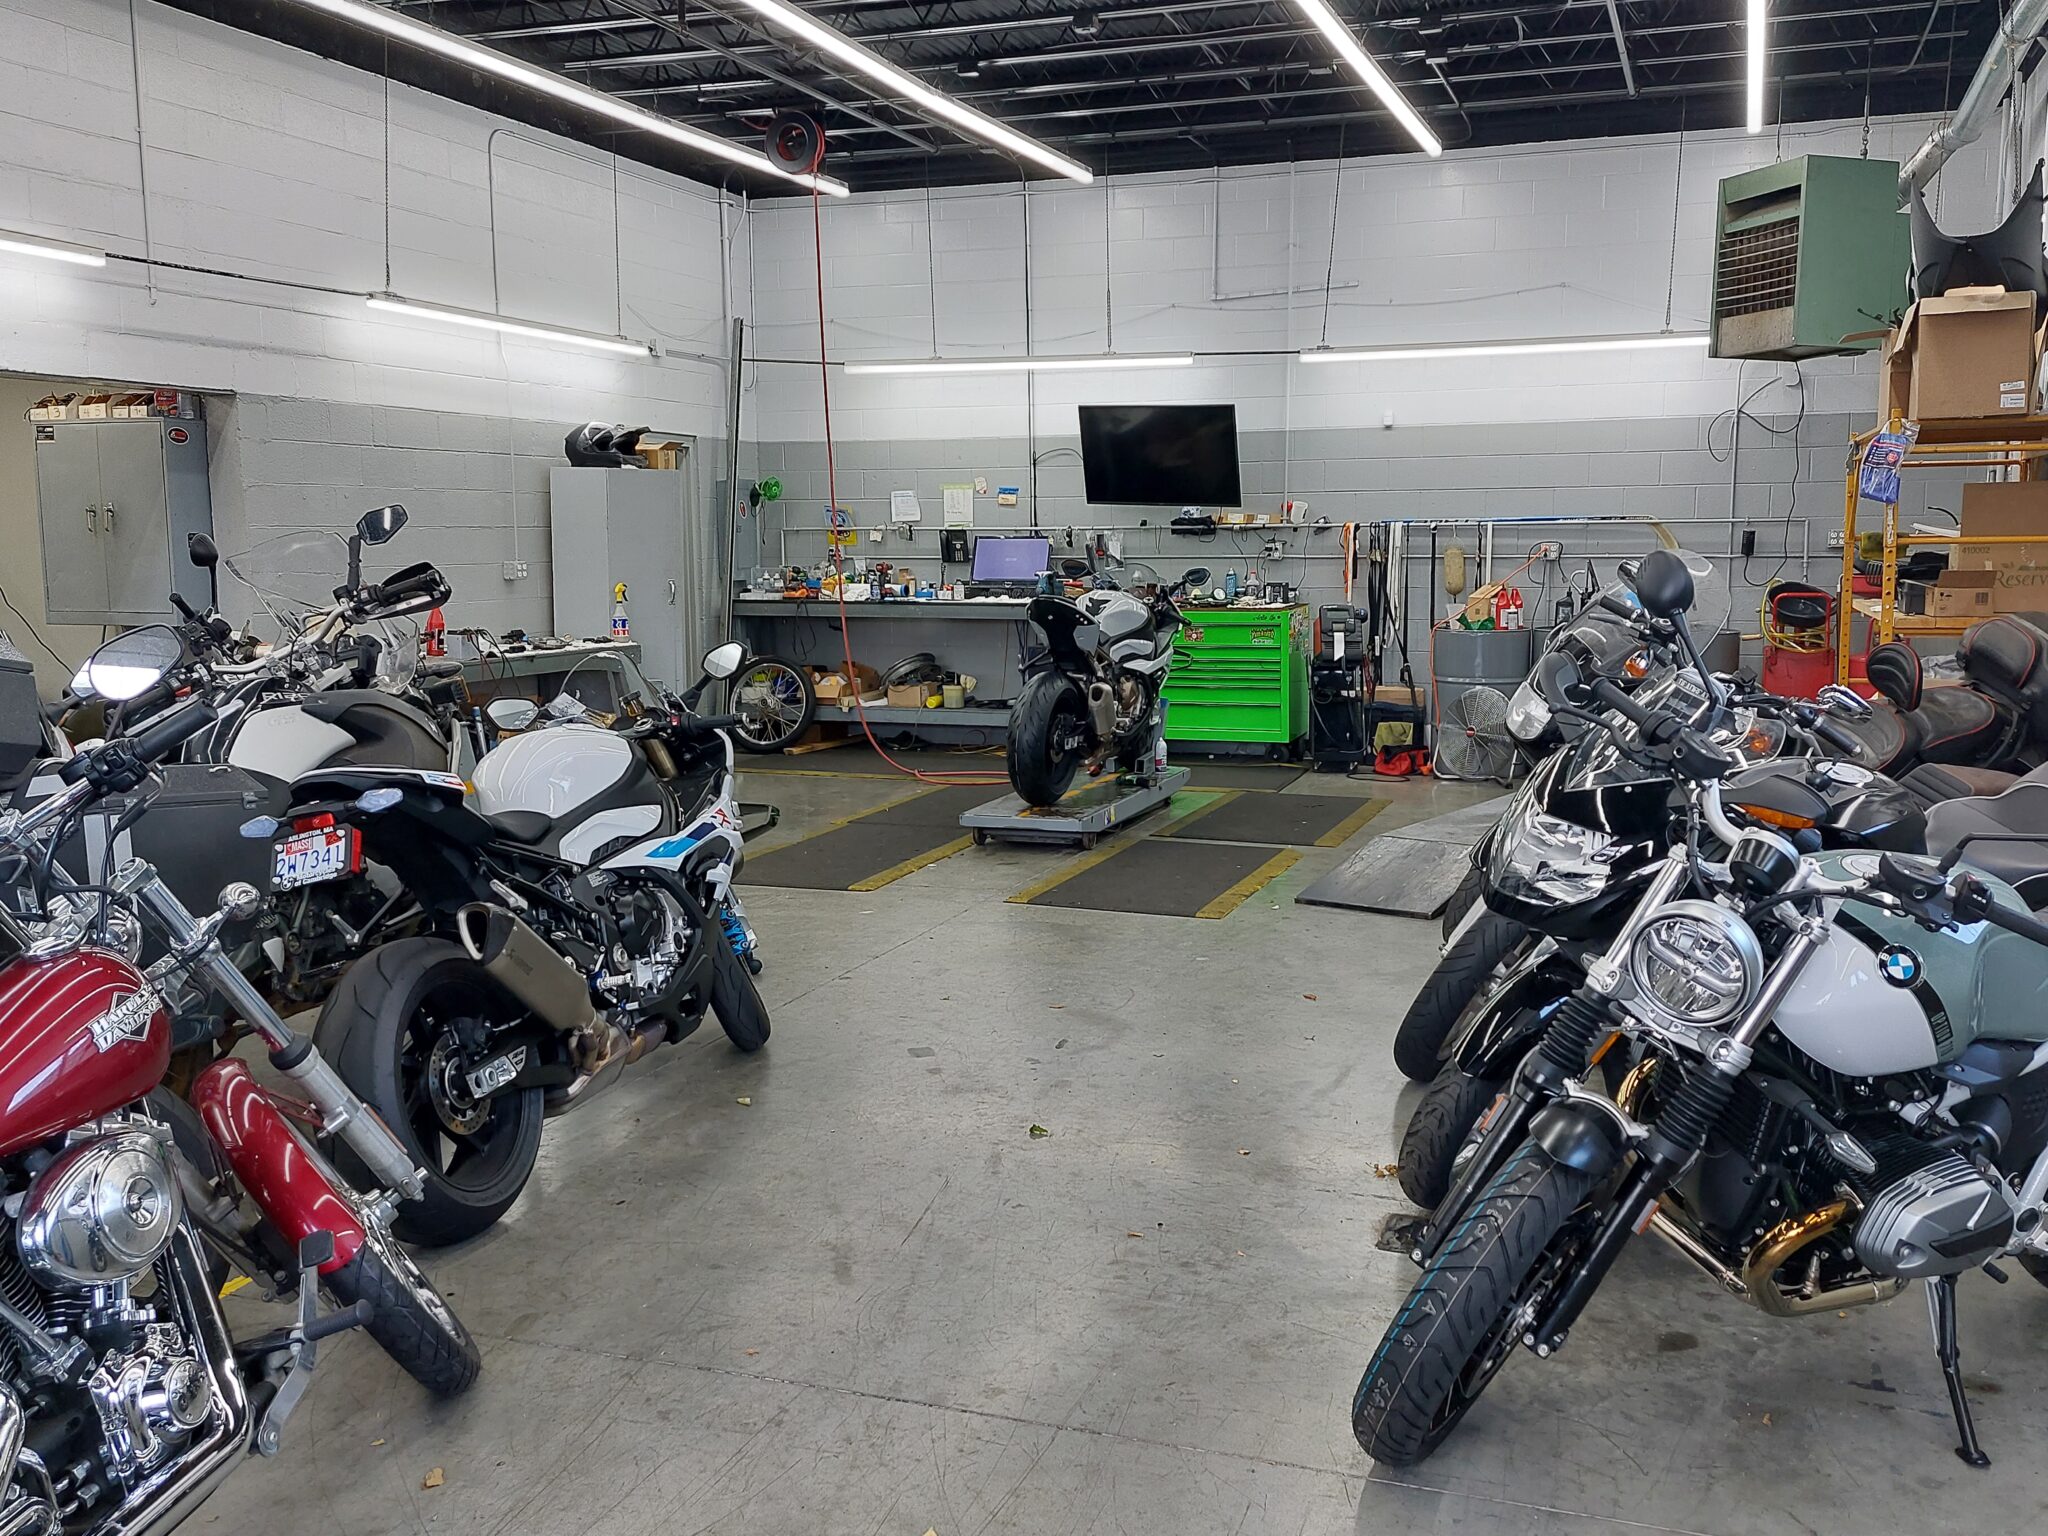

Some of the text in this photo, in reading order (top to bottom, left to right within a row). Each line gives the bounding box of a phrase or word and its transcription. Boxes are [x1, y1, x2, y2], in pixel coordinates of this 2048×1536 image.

[53, 407, 60, 417] 3
[1962, 546, 1991, 554] 410002
[323, 826, 334, 834] MA
[88, 983, 152, 1036] HARLEY
[94, 994, 162, 1053] DAVIDSON
